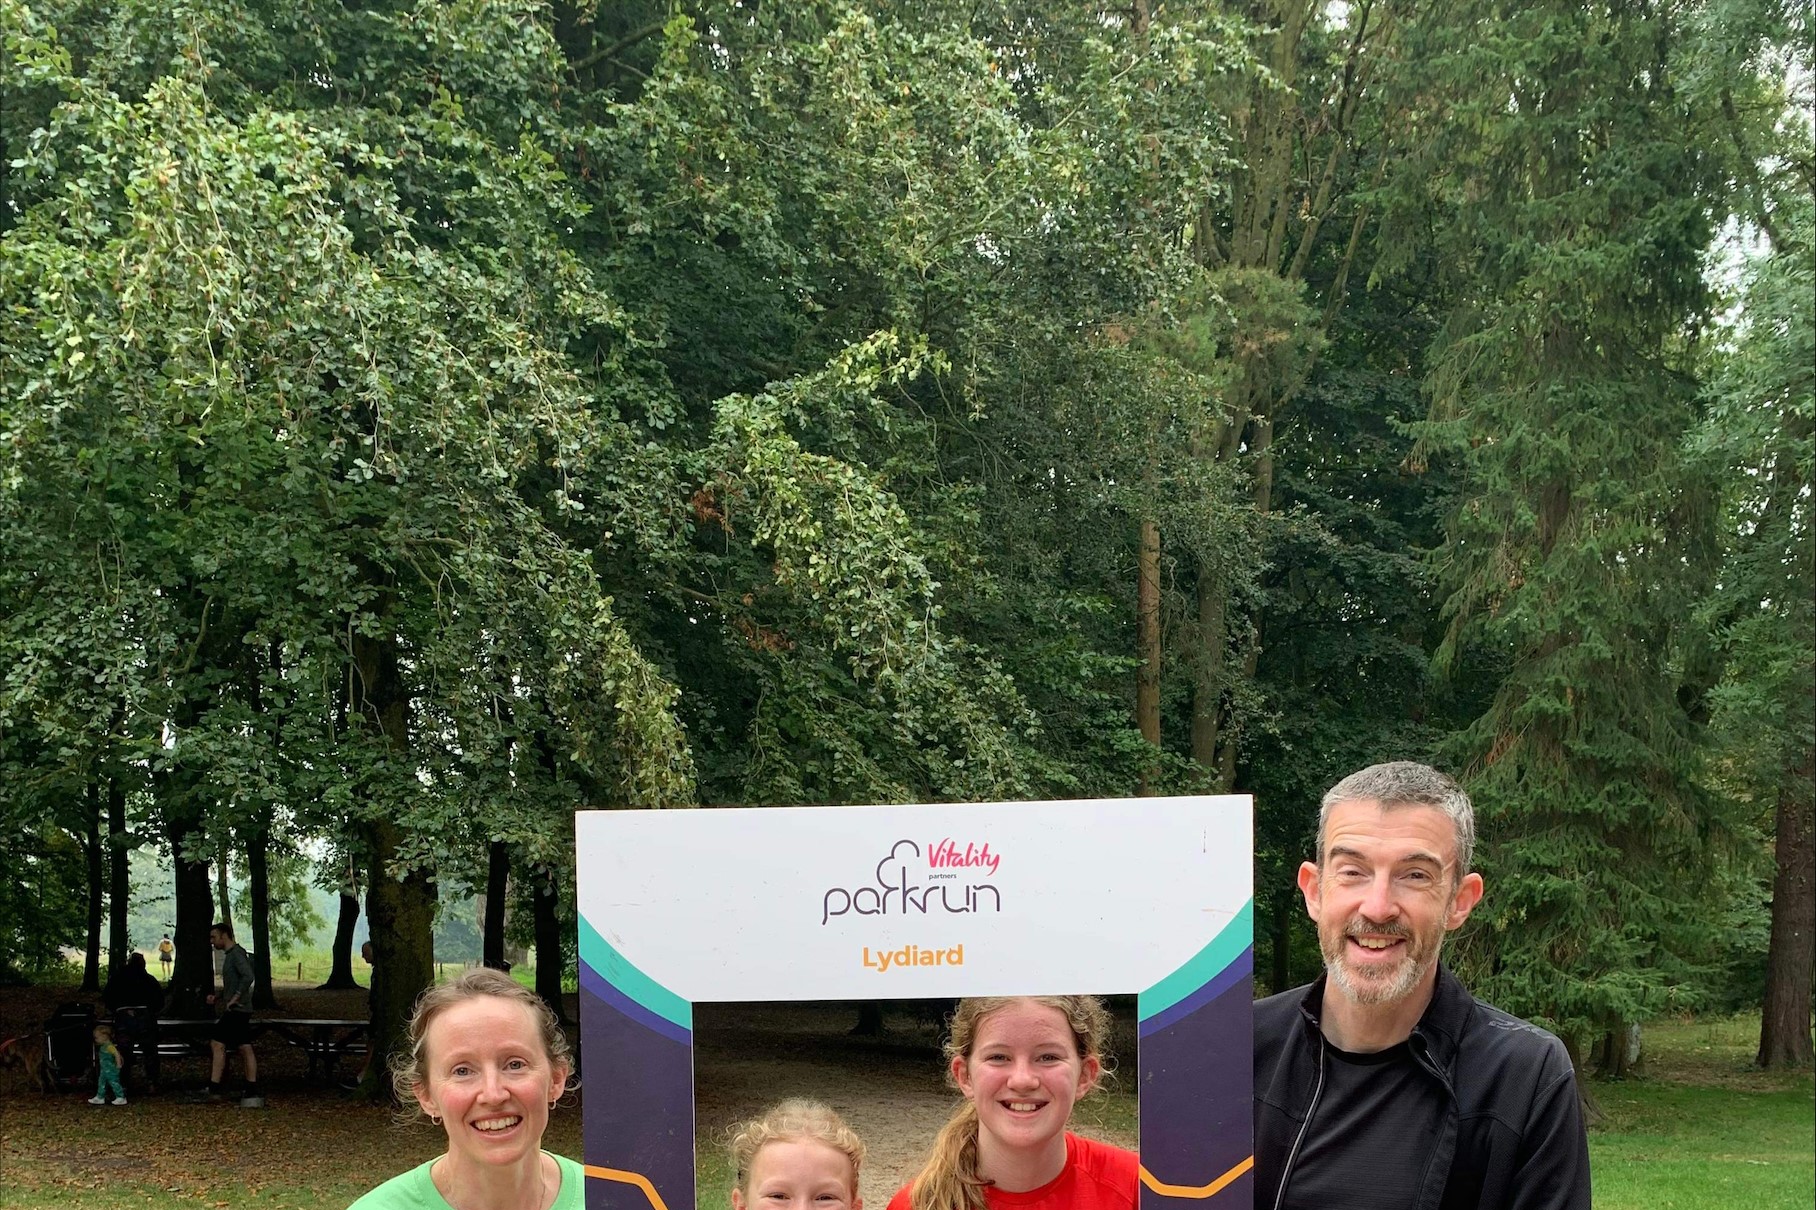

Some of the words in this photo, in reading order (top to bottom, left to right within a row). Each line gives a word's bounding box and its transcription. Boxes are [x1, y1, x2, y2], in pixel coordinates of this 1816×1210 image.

[928, 837, 1000, 876] Vitality
[929, 873, 957, 881] partners
[822, 866, 1001, 926] parkrun
[863, 944, 964, 973] Lydiard
